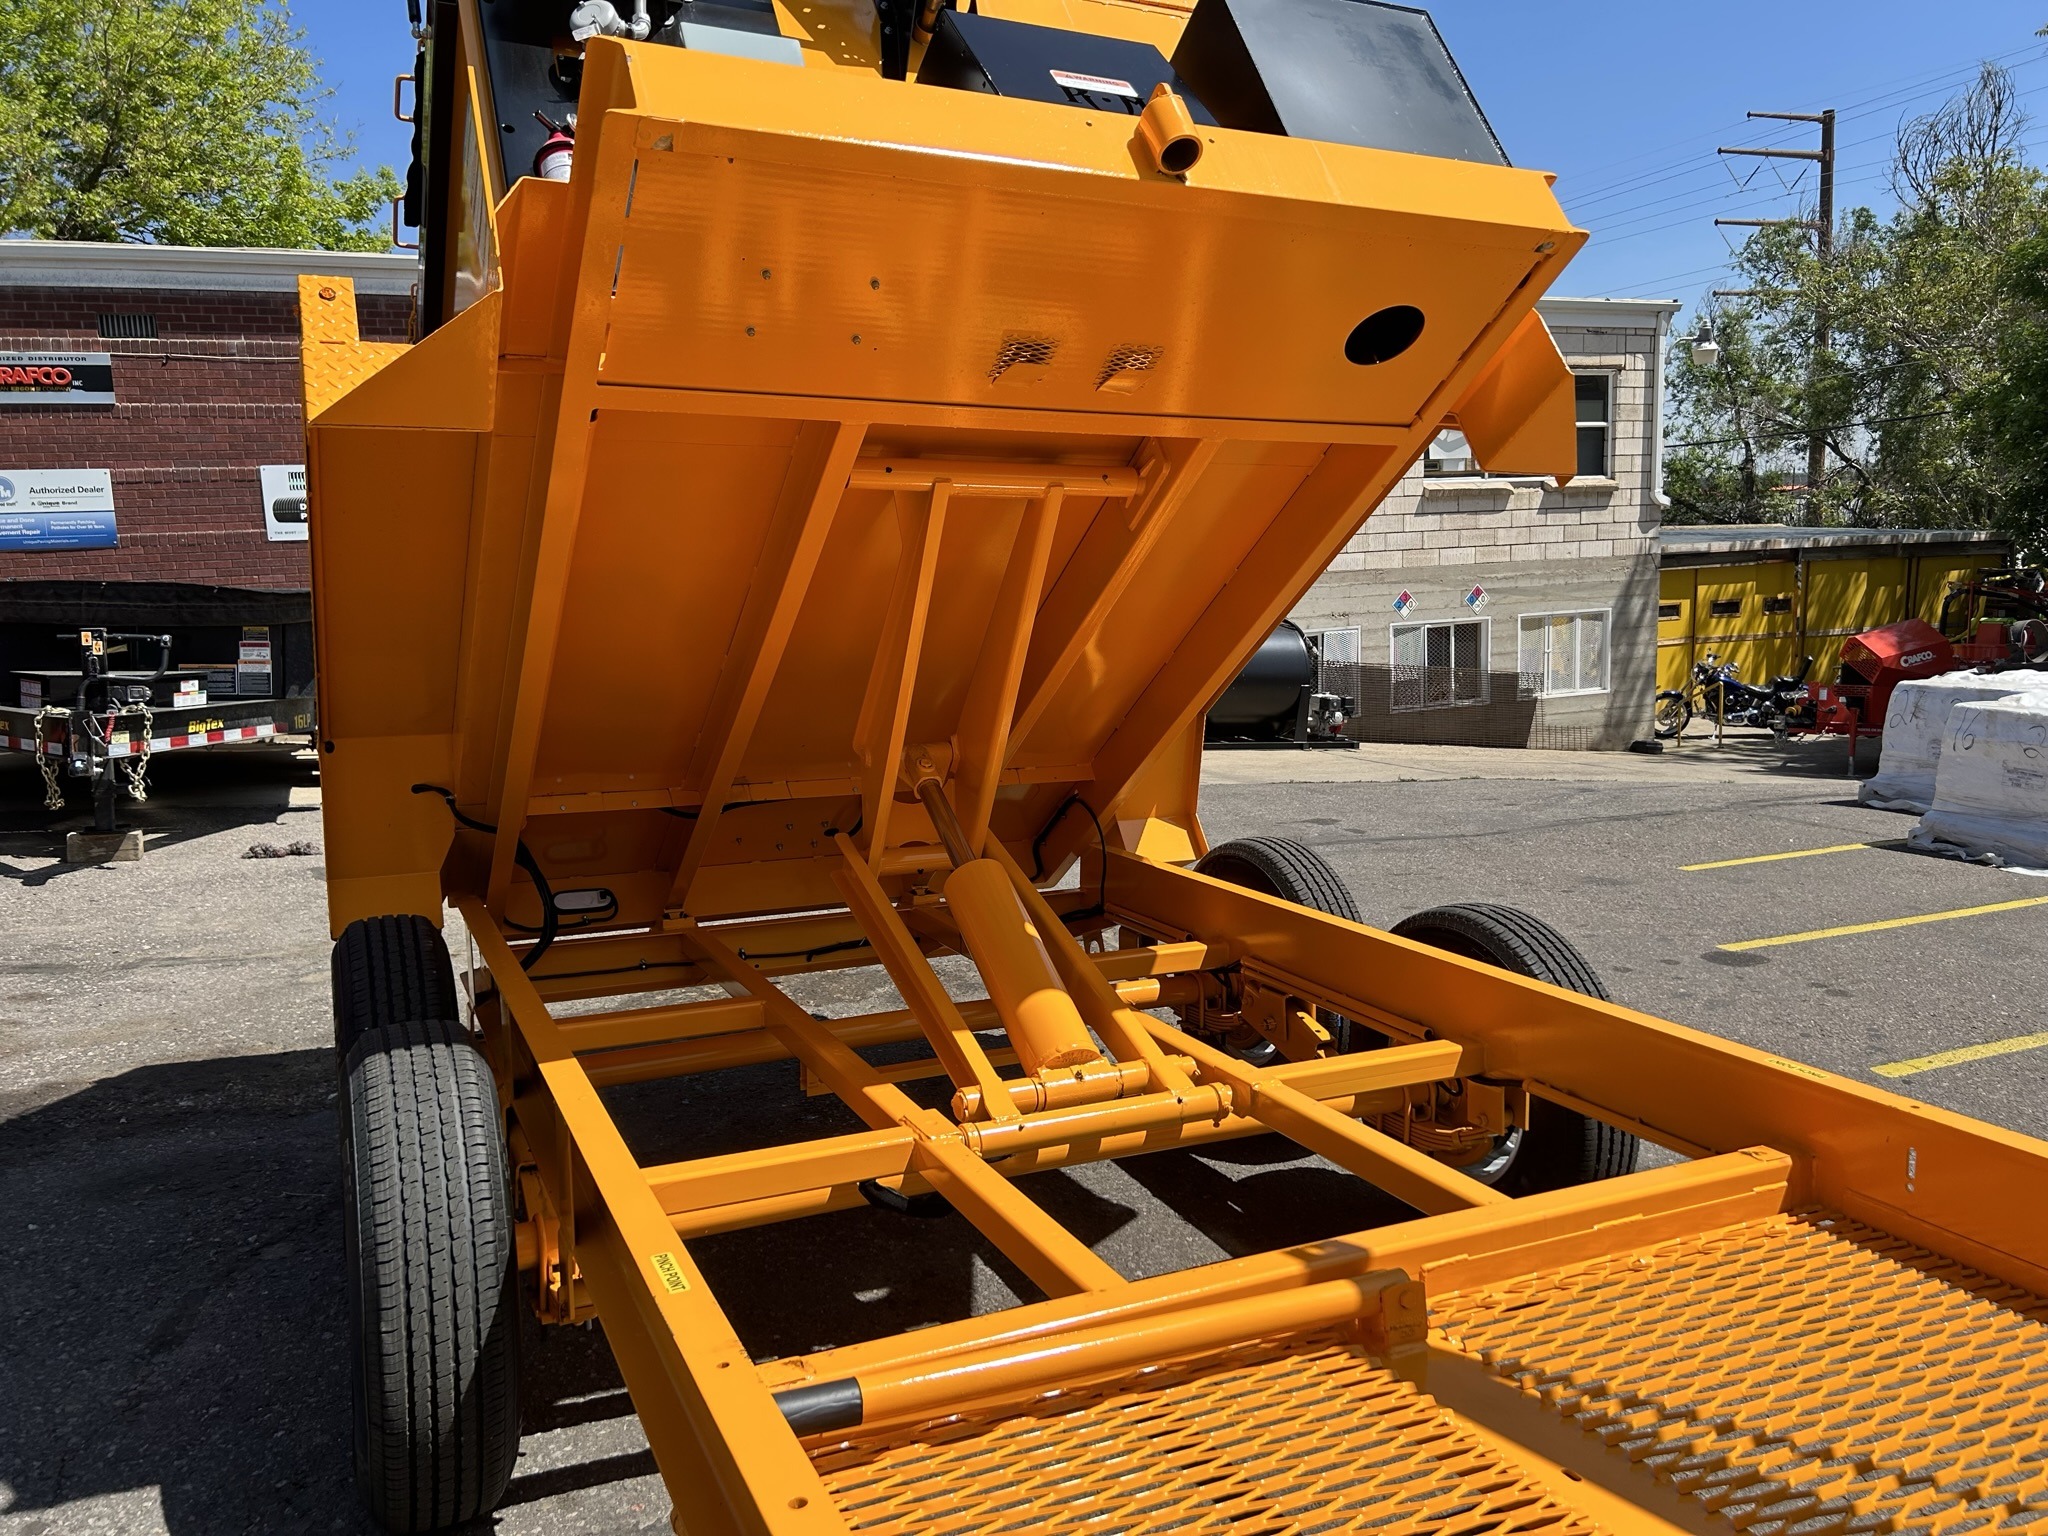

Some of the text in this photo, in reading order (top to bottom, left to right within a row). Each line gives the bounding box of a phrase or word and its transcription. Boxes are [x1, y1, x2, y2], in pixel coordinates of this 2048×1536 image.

[29, 485, 105, 494] Authorized Dealer
[1900, 650, 1933, 668] CRAFCO
[188, 718, 225, 734] BigTex
[294, 713, 311, 729] 16LP
[653, 1253, 686, 1291] PINCH POINT
